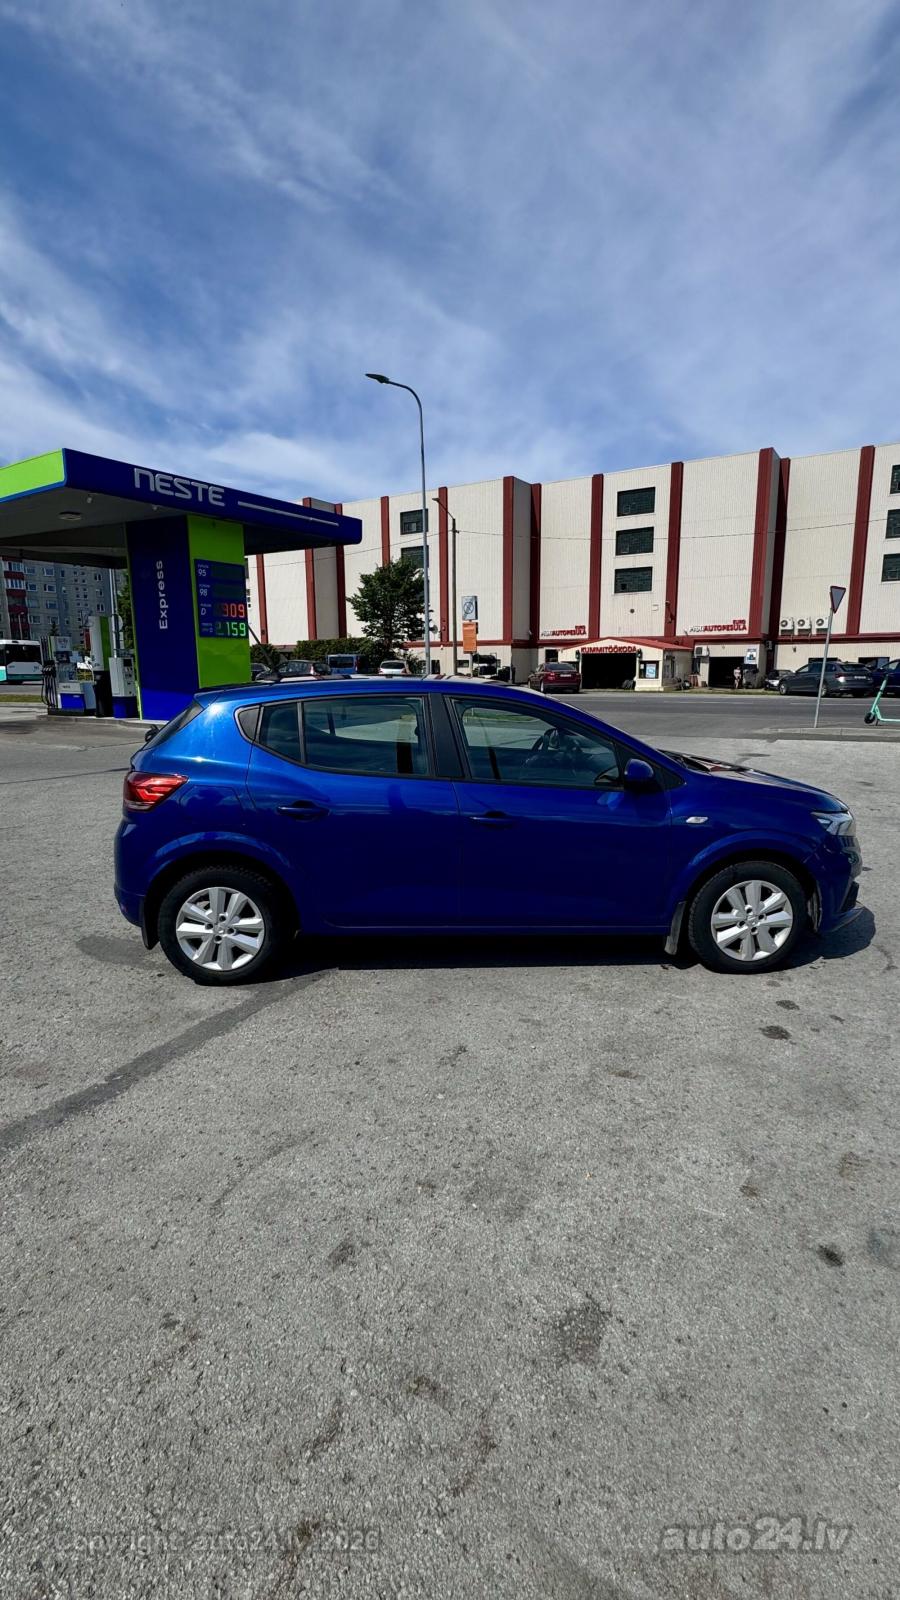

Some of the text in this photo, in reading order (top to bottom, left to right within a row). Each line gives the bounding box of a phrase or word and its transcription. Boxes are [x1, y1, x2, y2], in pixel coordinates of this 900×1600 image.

[134, 467, 225, 507] NESTE
[198, 569, 207, 577] 95
[156, 560, 169, 630] Express
[199, 589, 208, 597] 98
[200, 607, 207, 616] D
